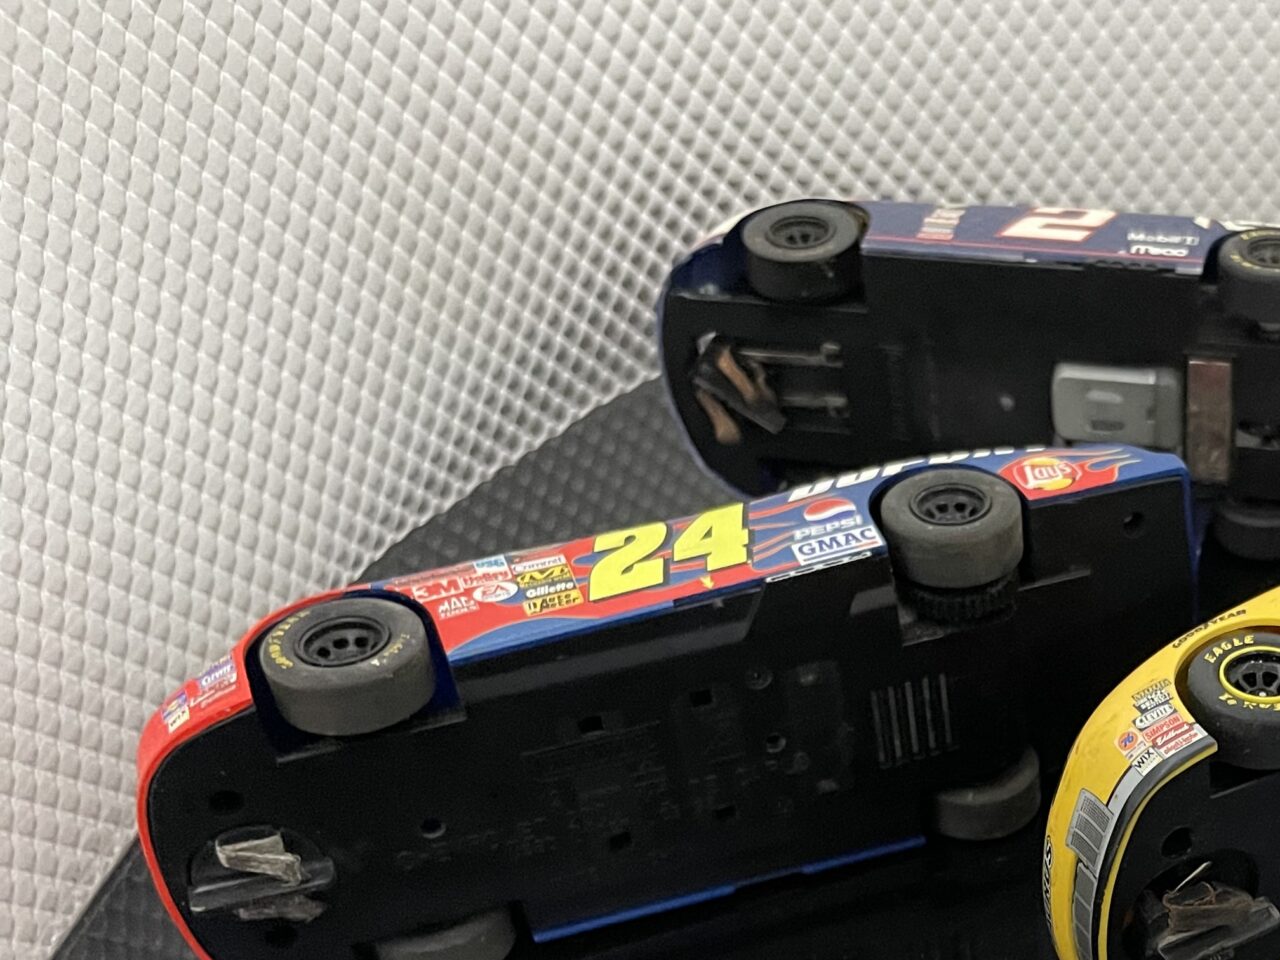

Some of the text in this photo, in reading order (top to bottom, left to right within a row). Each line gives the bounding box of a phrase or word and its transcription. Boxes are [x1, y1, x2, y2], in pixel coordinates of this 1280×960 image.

[999, 206, 1118, 243] 2
[793, 514, 864, 541] PEPSI
[589, 502, 750, 602] 24
[797, 527, 877, 557] GMAC
[525, 581, 575, 599] Gillette
[1204, 635, 1255, 664] EAGLE
[1145, 715, 1182, 741] SIMPSON
[1134, 749, 1155, 769] WIX
